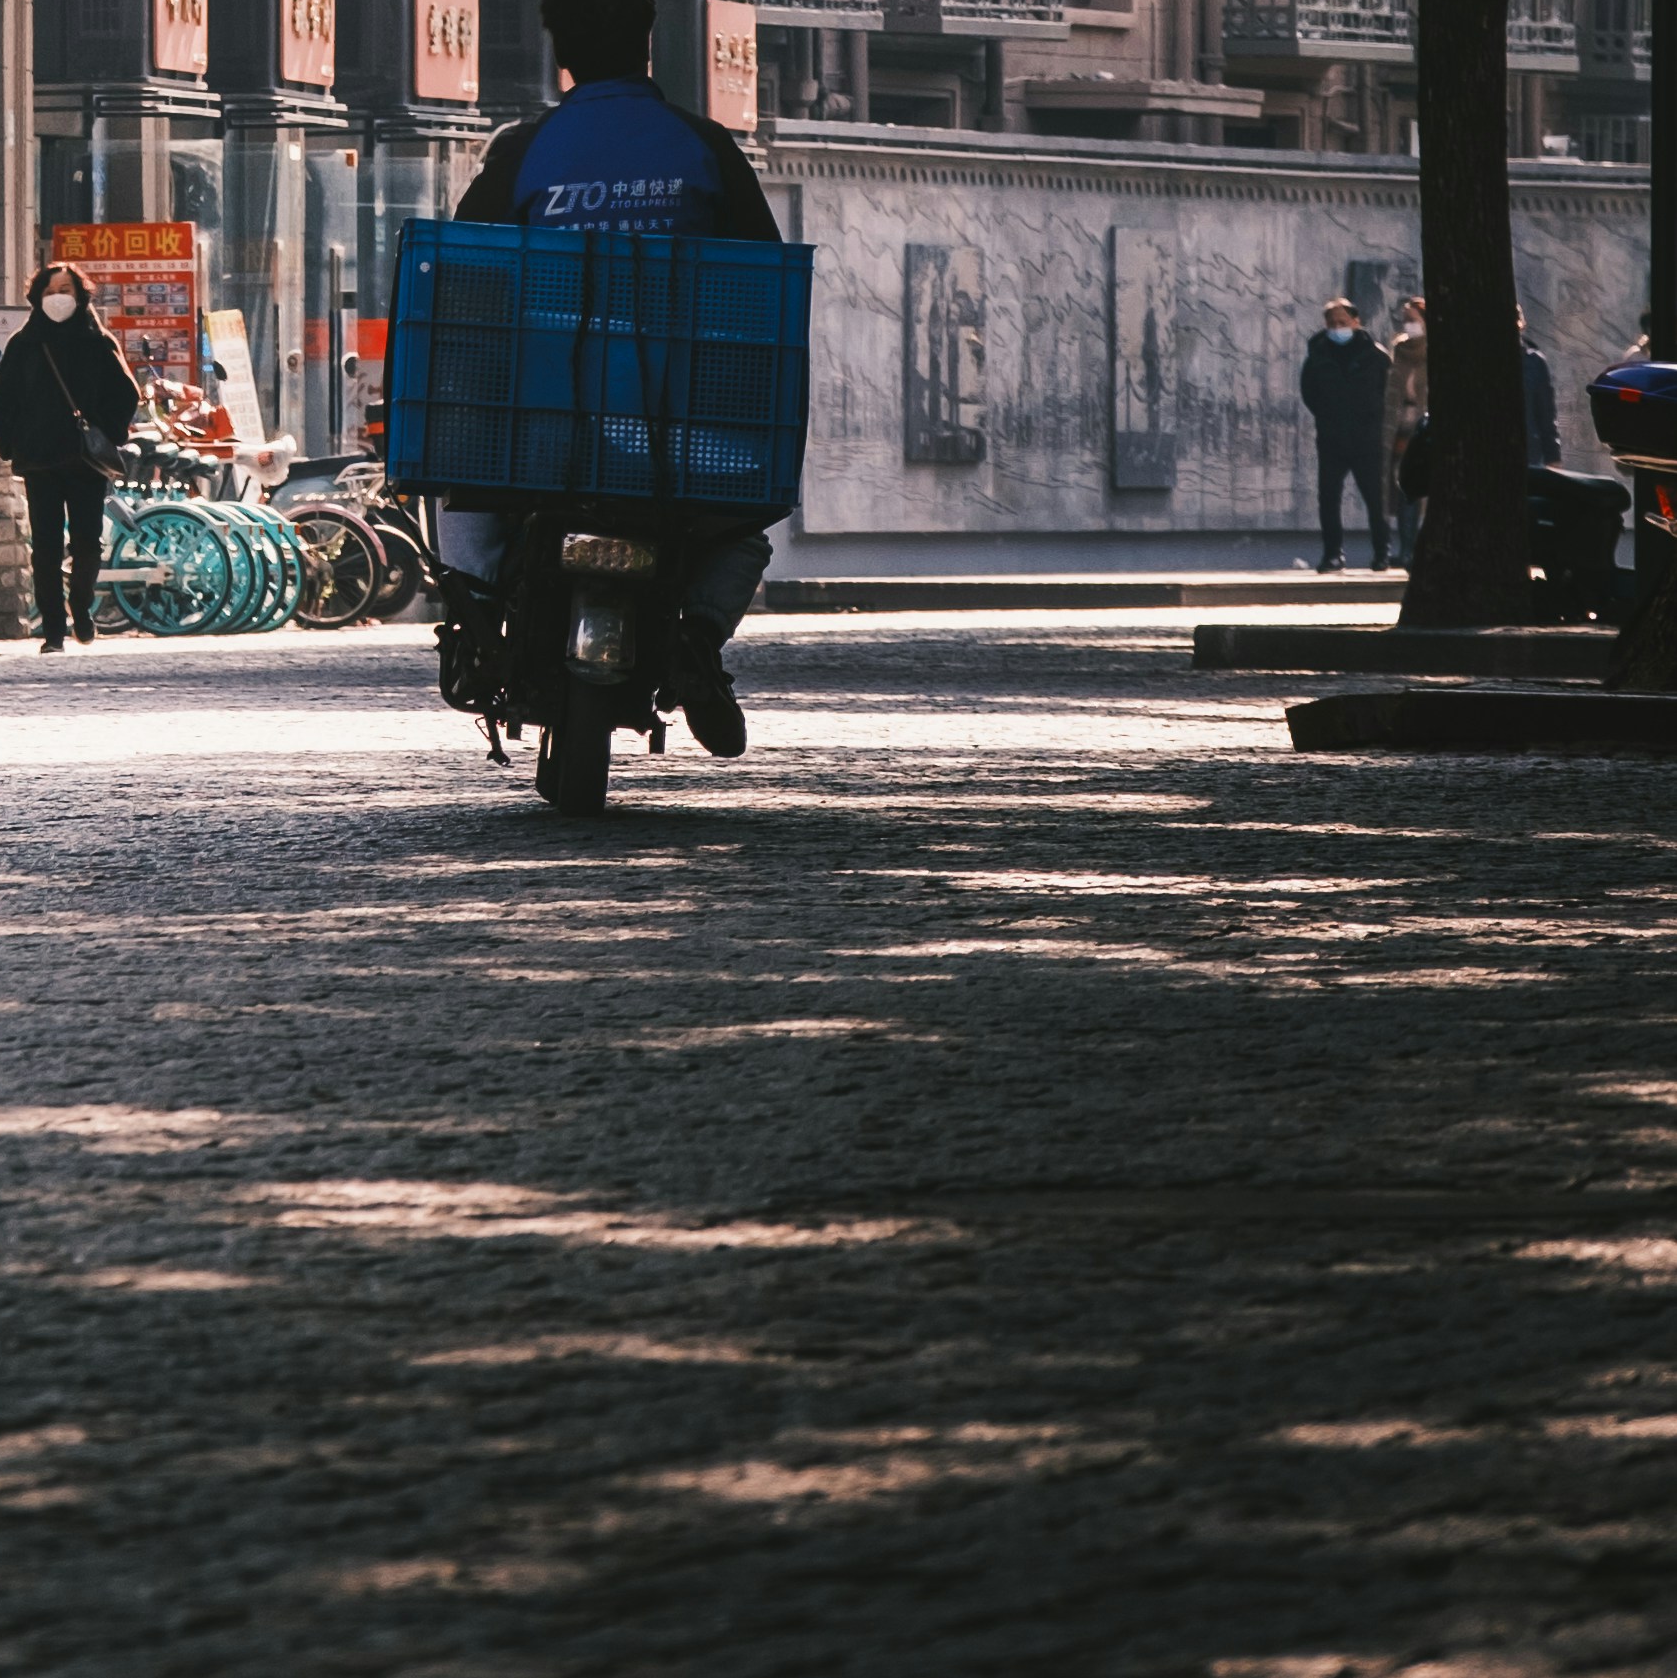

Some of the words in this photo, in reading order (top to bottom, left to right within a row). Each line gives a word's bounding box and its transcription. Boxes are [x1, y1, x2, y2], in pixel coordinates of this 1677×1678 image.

[544, 181, 608, 217] ZTO
[612, 178, 683, 198] 中通快递
[610, 200, 631, 209] ZTO
[59, 227, 183, 258] 高价回收
